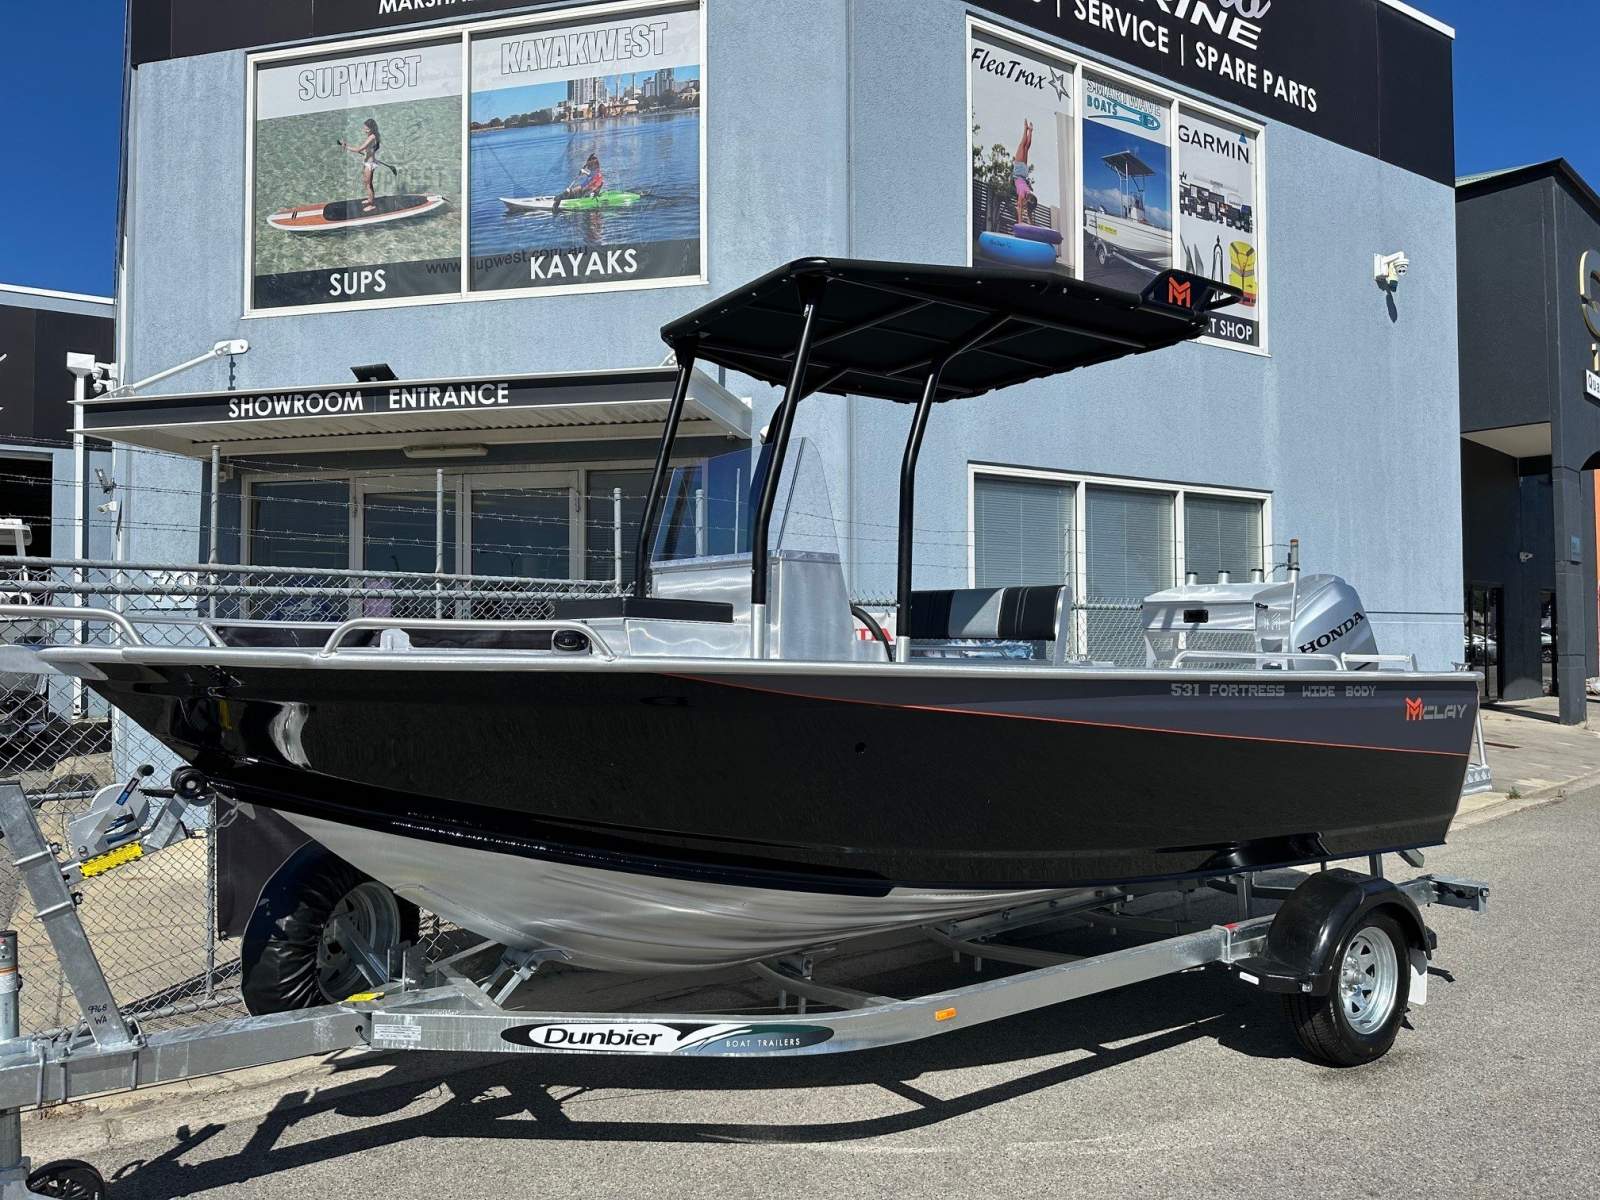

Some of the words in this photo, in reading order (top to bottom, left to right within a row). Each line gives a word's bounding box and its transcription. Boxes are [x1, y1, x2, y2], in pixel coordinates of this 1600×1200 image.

[501, 21, 668, 75] KAYAKWEST
[1073, 0, 1169, 54] SERVICE
[1195, 41, 1258, 89] SPARE
[1263, 69, 1318, 113] PARTS
[298, 54, 422, 102] SUPWEST
[971, 47, 1047, 90] FleaTrax
[1087, 94, 1119, 116] BOATS
[1178, 124, 1250, 164] GARMIN
[530, 248, 638, 280] KAYAKS
[329, 268, 387, 296] SUPS
[1219, 320, 1253, 341] SHOP
[228, 390, 364, 418] SHOWROOM
[388, 383, 509, 409] ENTRANCE
[1298, 611, 1364, 654] HONDA
[1171, 683, 1200, 697] 531
[1209, 684, 1286, 697] FORTRESS
[1302, 685, 1335, 697] WIDE
[1345, 685, 1376, 697] BODY
[543, 1027, 663, 1046] Dunbier
[726, 1040, 751, 1048] BOAT
[758, 1037, 800, 1048] TRAILERS
